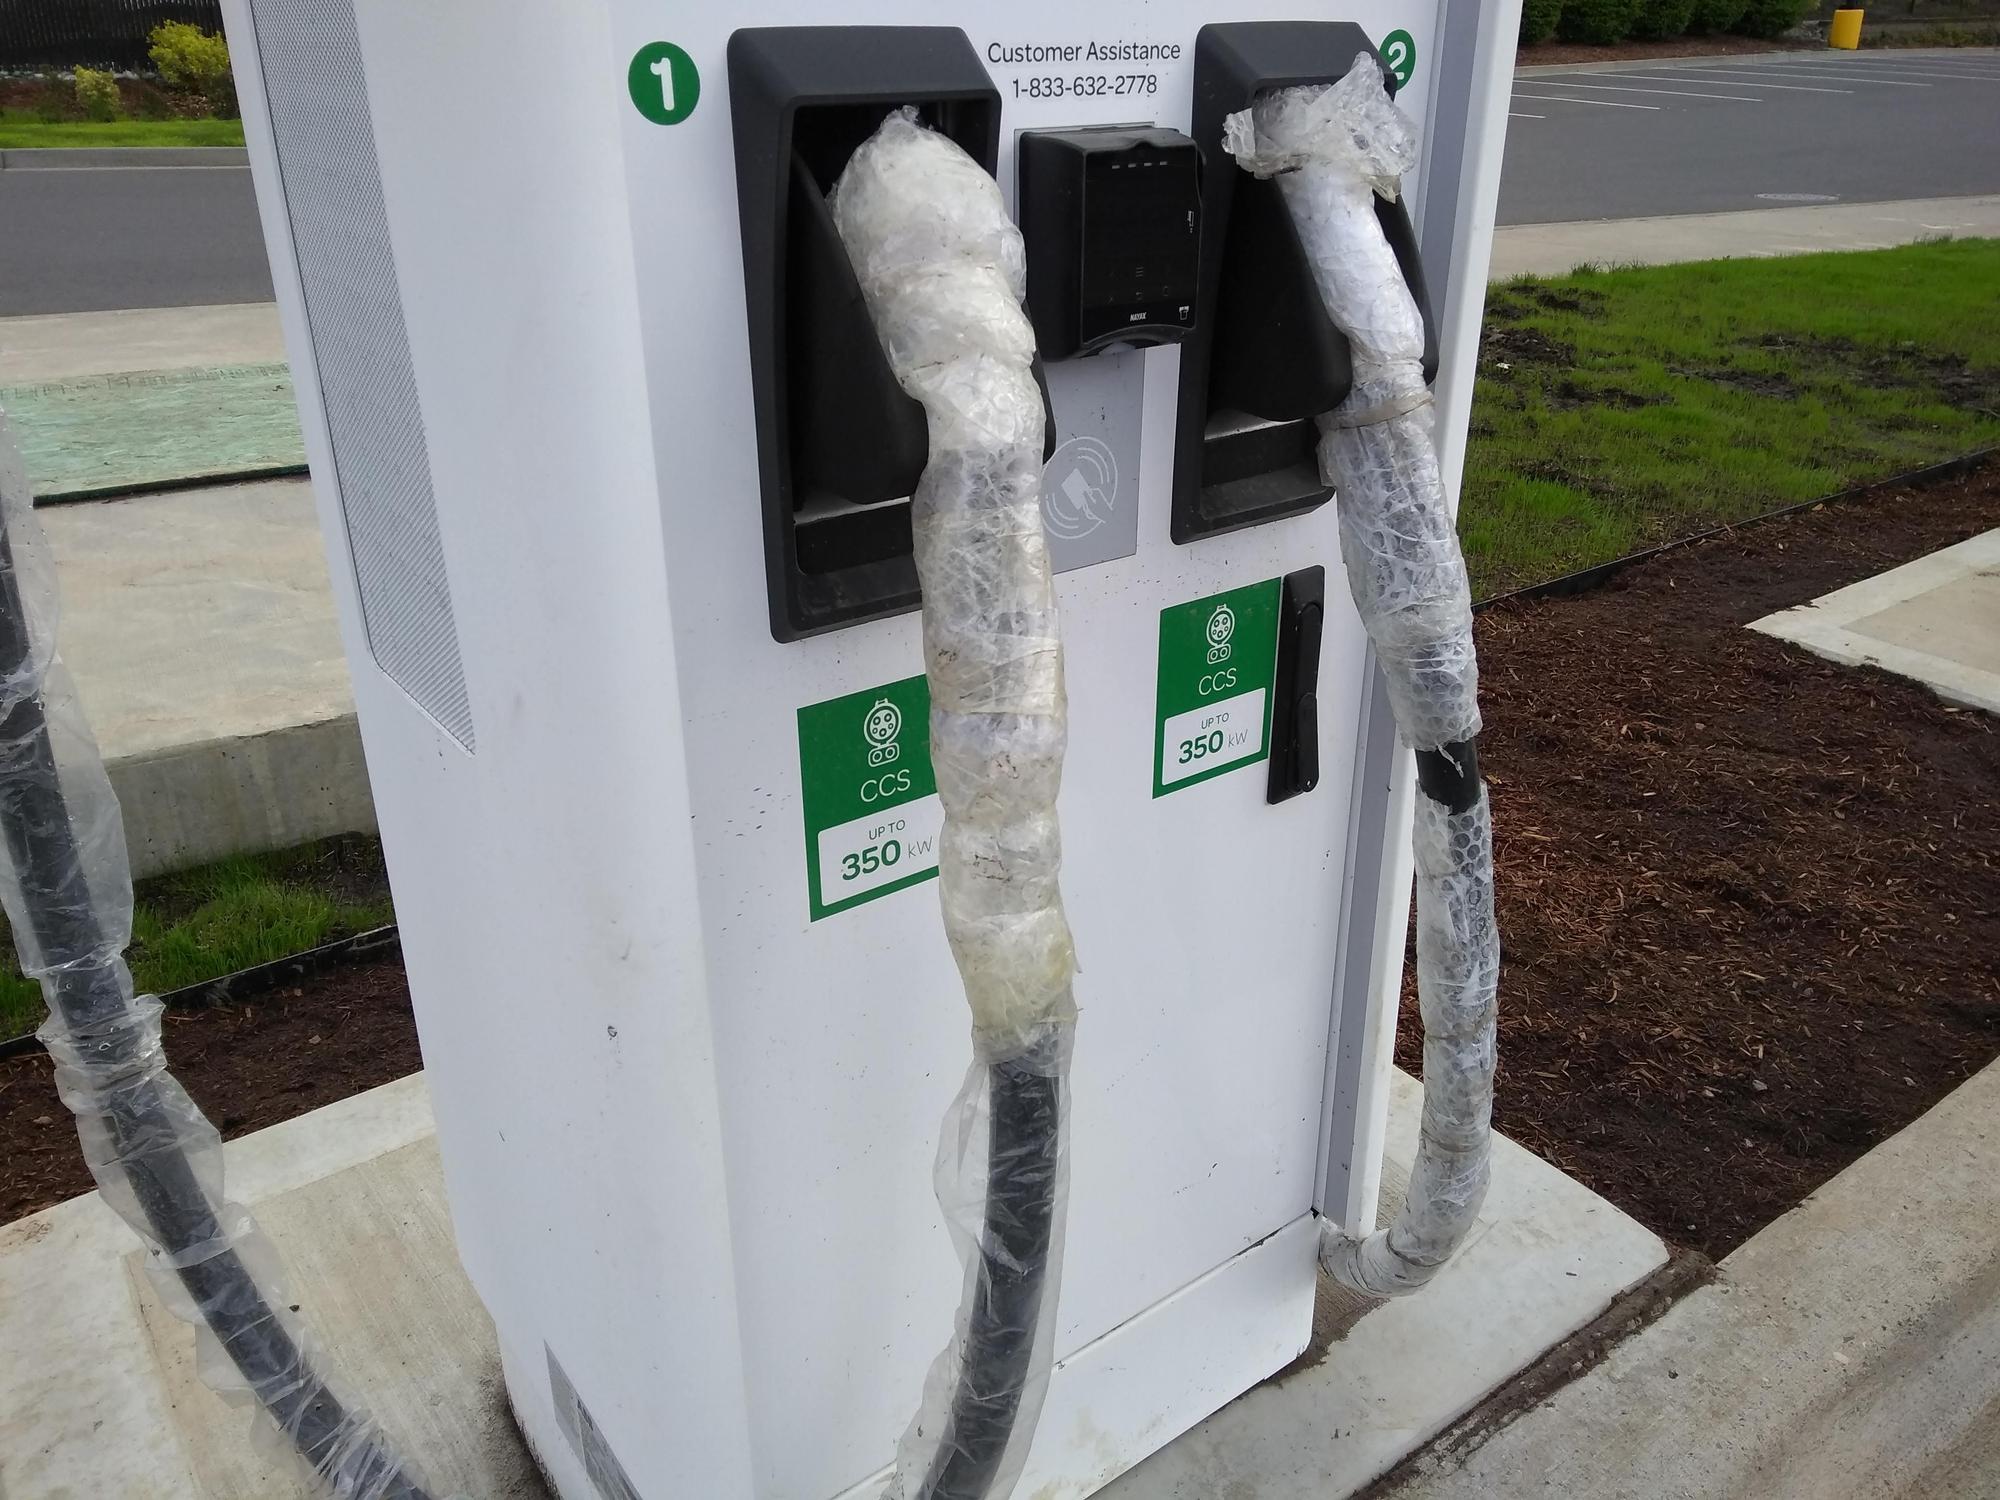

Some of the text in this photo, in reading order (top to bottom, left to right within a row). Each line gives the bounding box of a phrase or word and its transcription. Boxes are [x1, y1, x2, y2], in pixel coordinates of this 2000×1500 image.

[987, 40, 1181, 63] Customer Assistance
[1388, 41, 1407, 80] 2
[650, 57, 675, 111] 1
[1012, 74, 1158, 98] 1-833-632-2778
[1129, 311, 1147, 322] NAYAX
[1198, 667, 1237, 696] CCS
[1201, 712, 1230, 730] UP TO
[1178, 728, 1248, 764] 350 kW
[860, 768, 911, 802] CCS
[869, 819, 906, 841] UP TO
[842, 835, 933, 881] 350 kW
